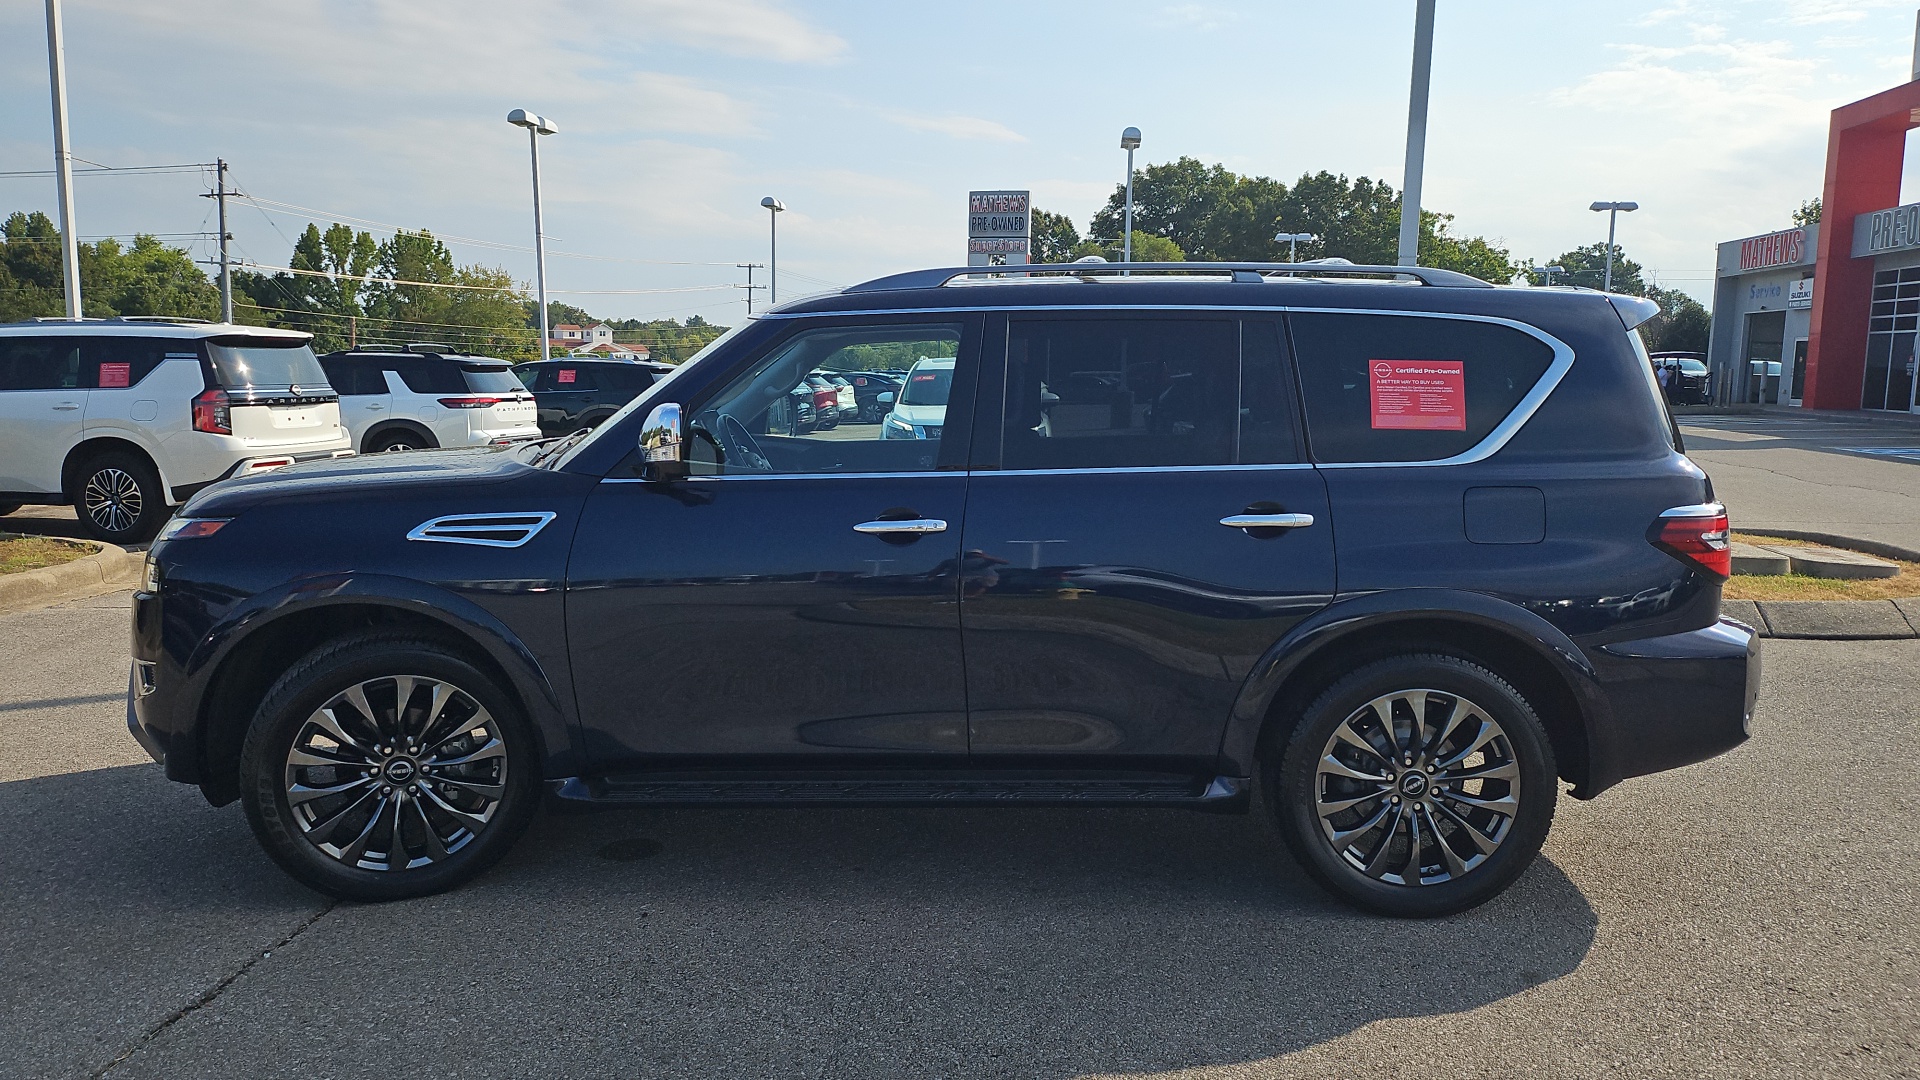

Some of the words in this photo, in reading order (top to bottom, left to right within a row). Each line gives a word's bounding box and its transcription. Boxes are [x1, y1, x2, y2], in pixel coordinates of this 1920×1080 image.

[971, 195, 1026, 212] MATHEWS
[971, 216, 1025, 231] PRE-OWNED
[1869, 204, 1920, 250] PRE-O
[1739, 229, 1803, 271] MATHEWS
[1750, 282, 1782, 299] Service
[1790, 291, 1811, 299] SUZUKI
